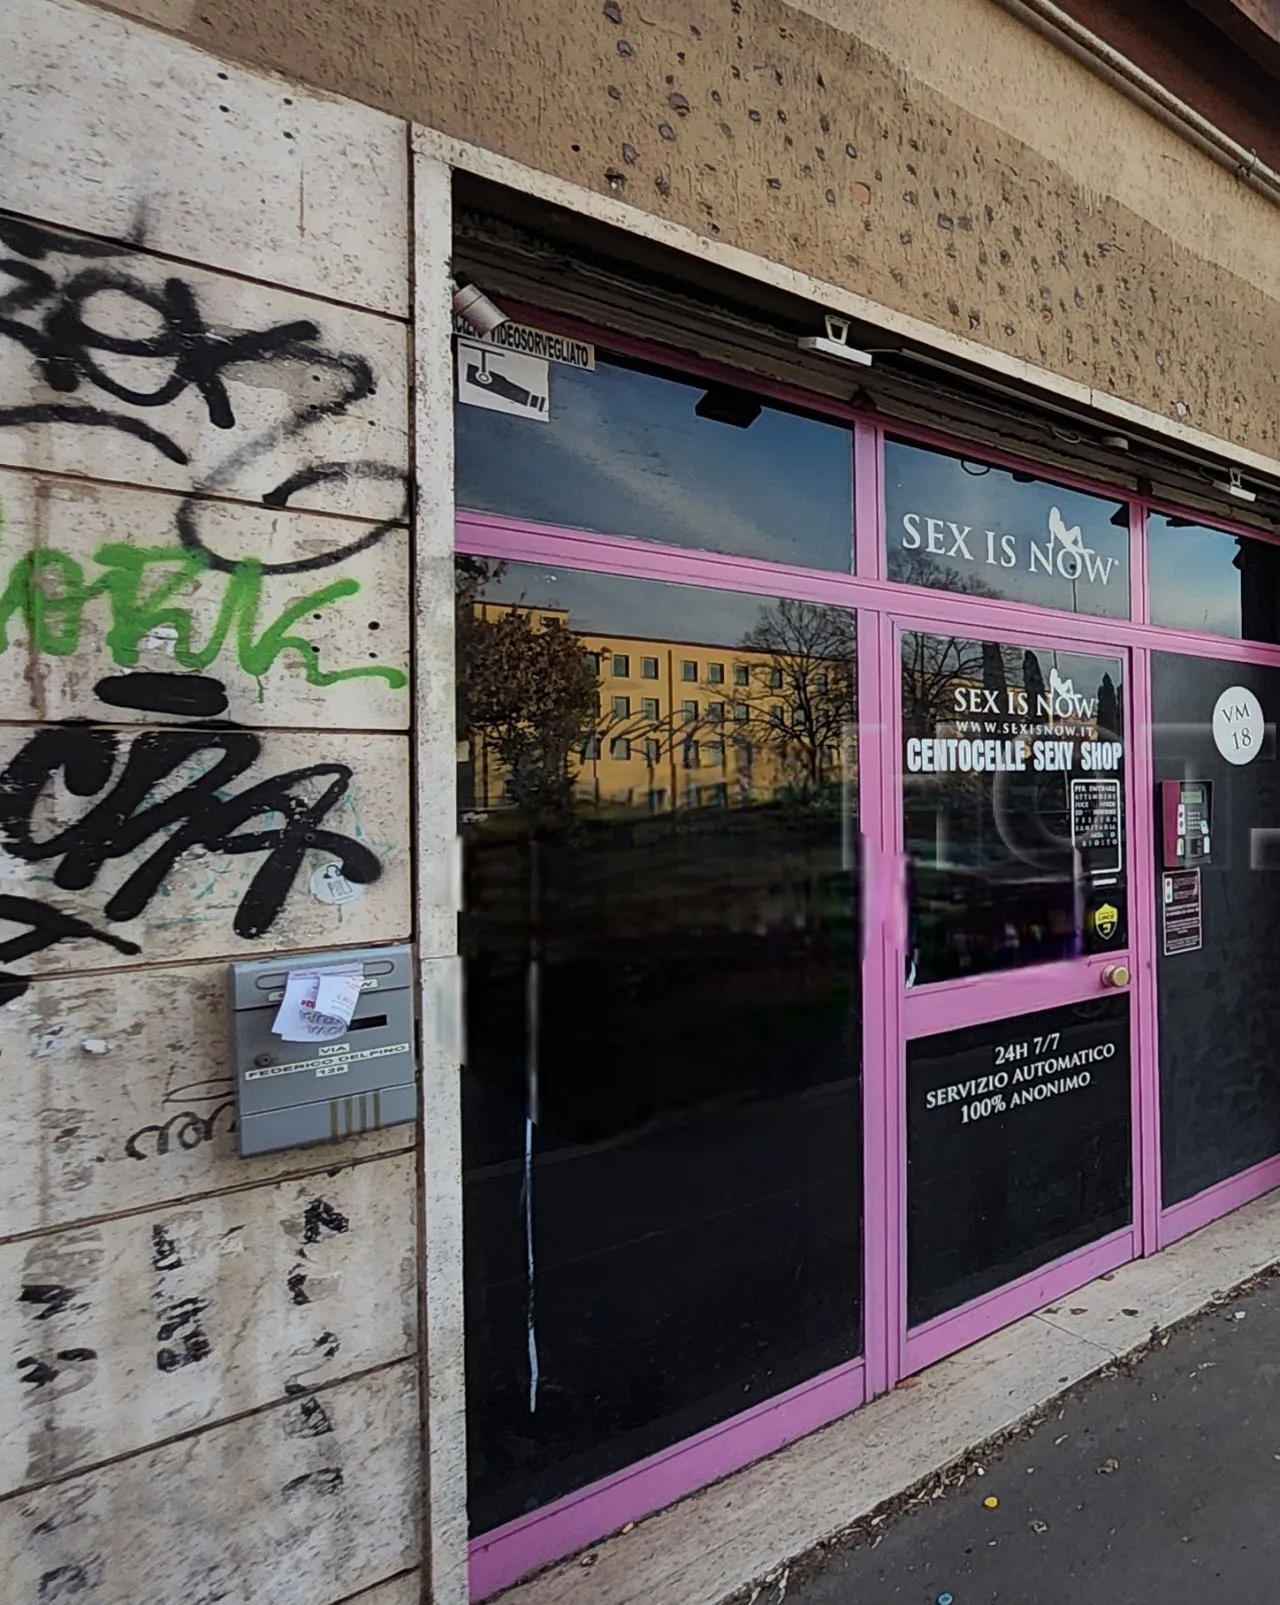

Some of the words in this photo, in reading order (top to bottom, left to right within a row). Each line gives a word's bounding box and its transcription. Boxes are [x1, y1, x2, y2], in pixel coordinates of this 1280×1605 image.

[490, 323, 589, 367] VIDEOSORVEGLIATO
[902, 513, 975, 560] SEX
[985, 530, 1016, 568] IS
[1028, 540, 1113, 586] NOW
[953, 687, 1000, 715] SEX
[1007, 691, 1029, 716] IS
[1036, 694, 1096, 718] NOW
[1220, 701, 1250, 724] VM
[955, 720, 1094, 737] WWW.SEXISNOW.IT
[1231, 728, 1252, 752] 18
[907, 737, 1026, 772] CENTOCELLE
[1033, 740, 1074, 771] SEXY
[1080, 741, 1123, 771] SHOP
[248, 1058, 333, 1078] FEDERICO
[338, 1045, 406, 1063] DELPINO
[320, 1045, 347, 1054] VIA
[994, 1042, 1028, 1065] 24H
[1033, 1032, 1061, 1056] 7/7
[926, 1072, 1009, 1109] SERVIZIO
[1012, 1043, 1116, 1085] AUTOMATICO
[960, 1094, 1006, 1124] 100%
[1010, 1071, 1091, 1109] ANONIMO
